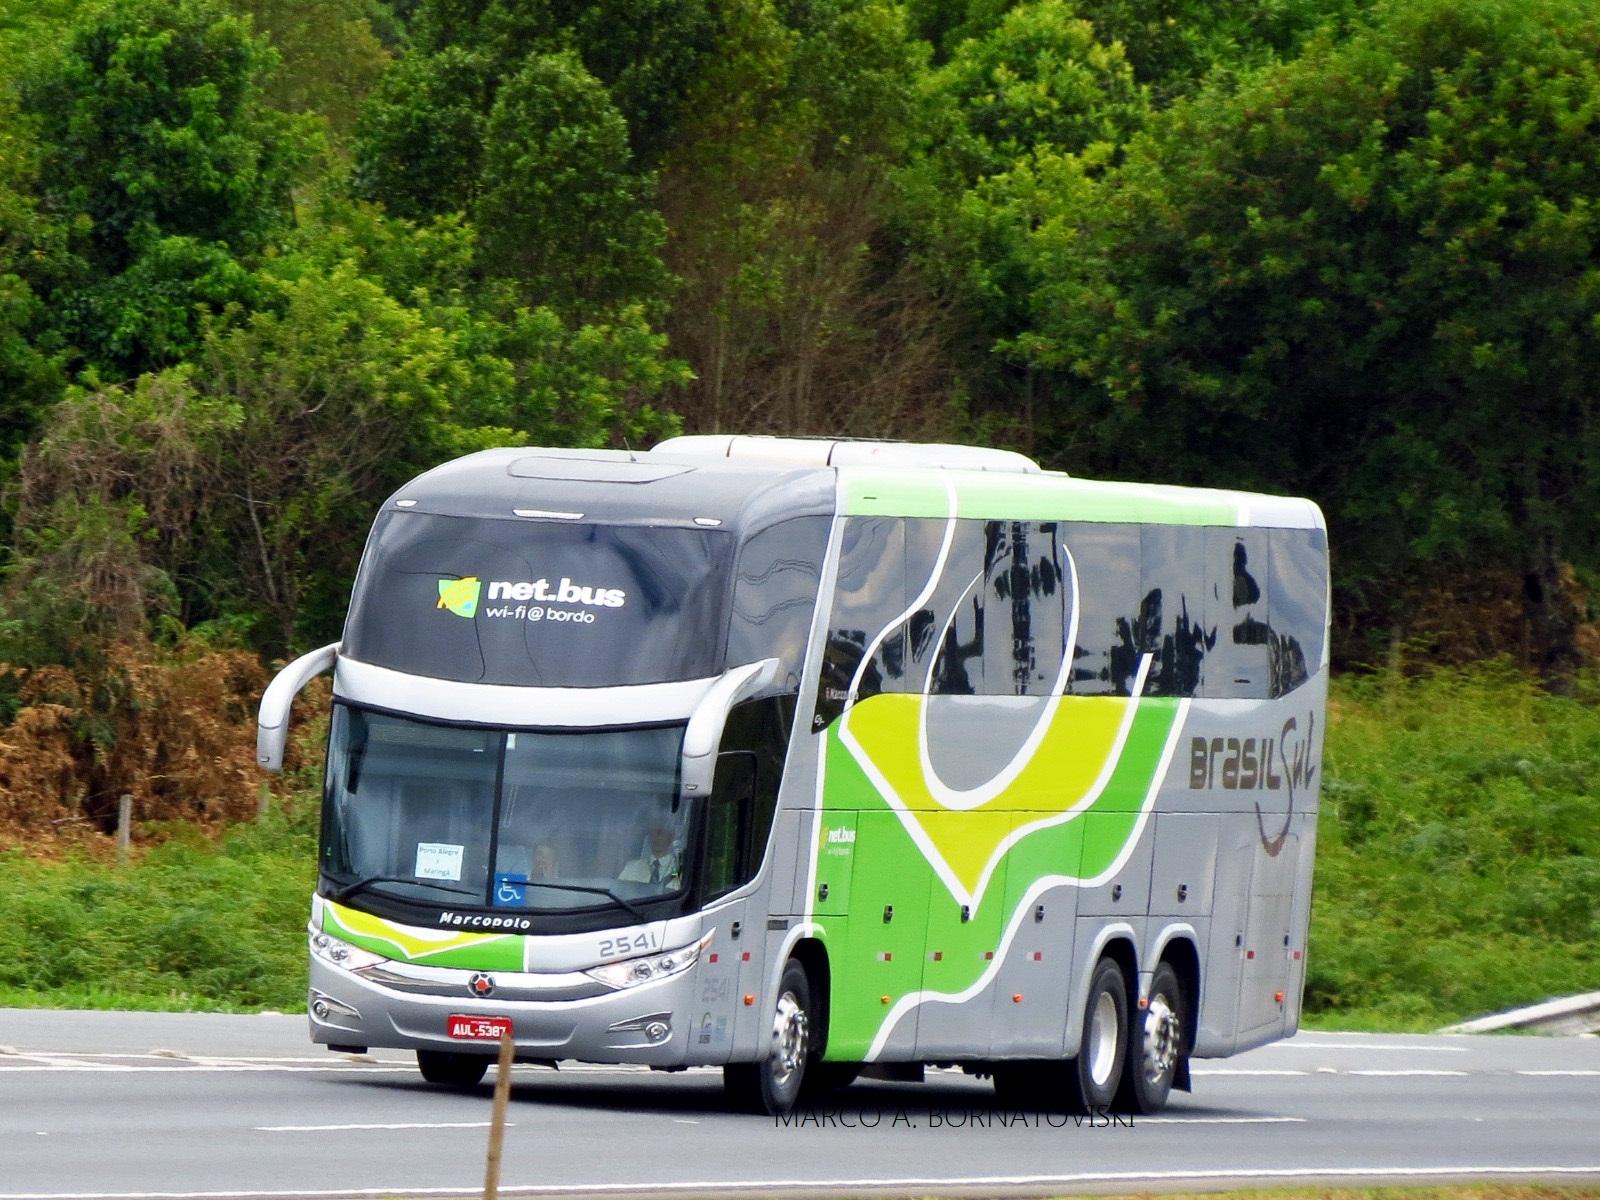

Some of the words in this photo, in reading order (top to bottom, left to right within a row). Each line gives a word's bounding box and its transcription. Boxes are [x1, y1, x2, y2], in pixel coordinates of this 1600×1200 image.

[487, 577, 626, 607] net.bus
[828, 825, 856, 843] net.bus
[439, 911, 531, 930] Marcopolo
[600, 931, 660, 958] 2541
[452, 1023, 506, 1038] AUL-5387
